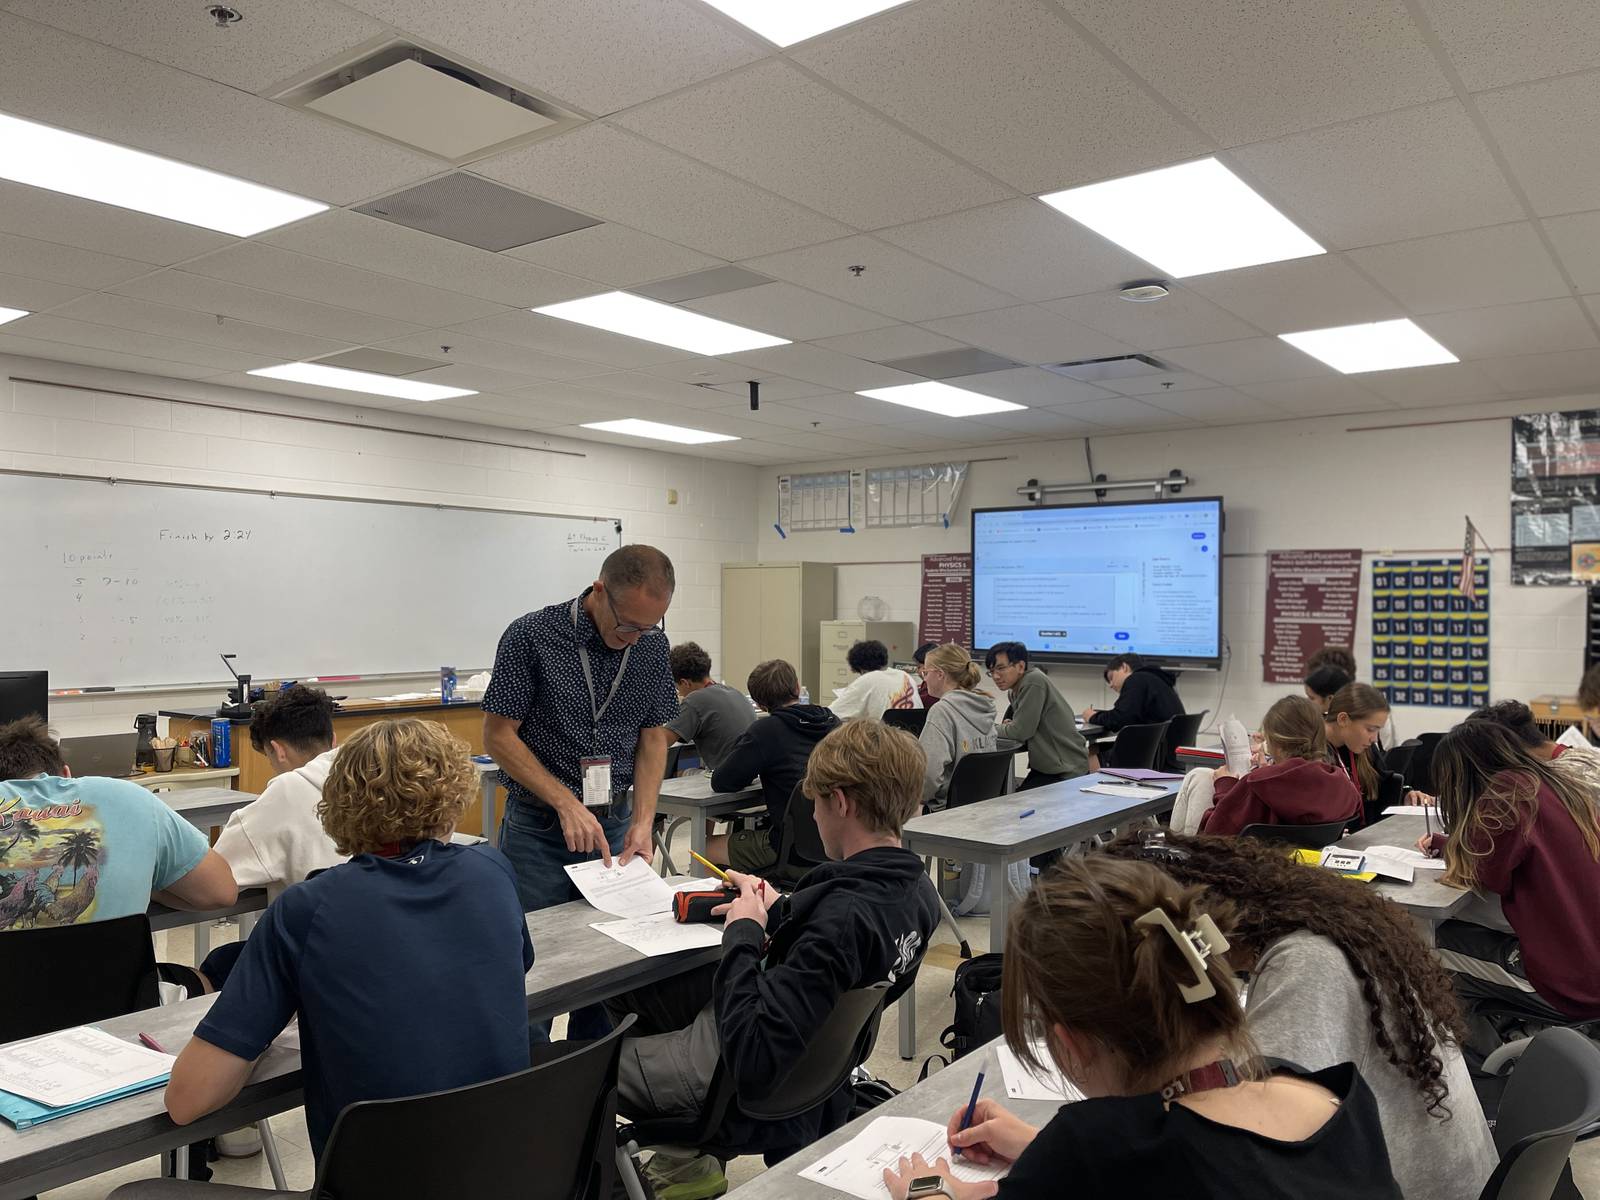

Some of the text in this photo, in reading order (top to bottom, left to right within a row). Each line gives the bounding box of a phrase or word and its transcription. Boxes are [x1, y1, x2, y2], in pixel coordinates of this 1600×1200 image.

[1376, 577, 1387, 586] 01
[1395, 577, 1405, 586] 02
[1434, 600, 1444, 609] 10
[1455, 600, 1464, 608] 11
[1377, 623, 1387, 631] 13
[1396, 623, 1405, 631] 14
[1414, 623, 1424, 632] 15
[1434, 623, 1444, 633] 16
[1454, 624, 1463, 632] 17
[1377, 646, 1483, 657] 19 20 21 22 23 24
[1377, 669, 1483, 680] 25 26 27 28 29 30
[1396, 692, 1405, 701] 32
[1414, 693, 1424, 702] 33
[1433, 694, 1443, 703] 34
[1453, 695, 1463, 704] 35
[1473, 696, 1483, 705] 36
